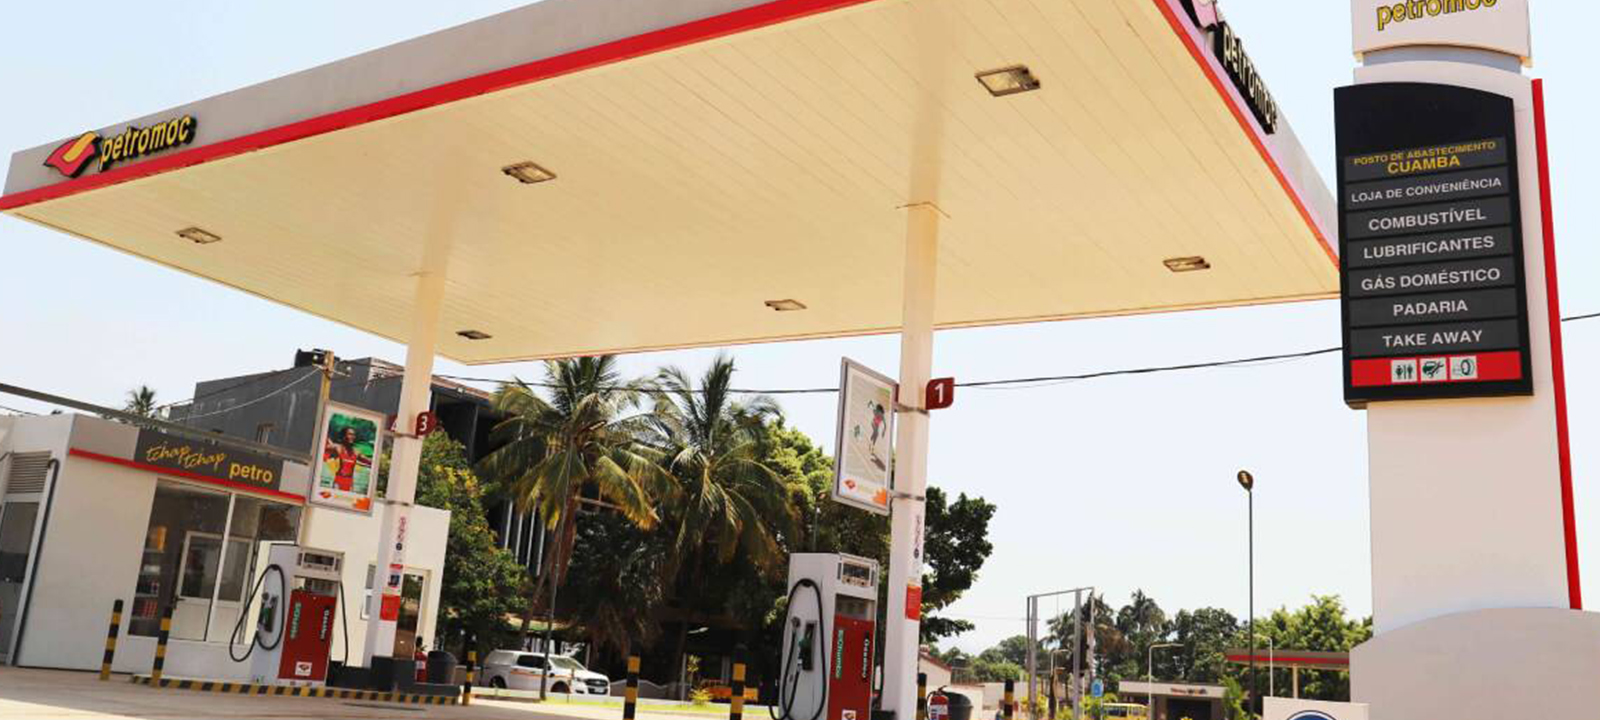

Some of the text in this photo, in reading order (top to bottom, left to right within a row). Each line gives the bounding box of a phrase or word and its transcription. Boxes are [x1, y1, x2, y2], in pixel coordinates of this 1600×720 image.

[98, 114, 195, 172] petromoc
[1353, 141, 1497, 165] POSTO DE ABASTECIMENTO
[1387, 155, 1461, 174] CUAMBA
[1351, 177, 1502, 203] LOJA DE CONVENIÊNCIA
[1368, 208, 1487, 231] COMBUSTÍVEL
[1363, 235, 1496, 259] LUBRIFICANTES
[1361, 267, 1501, 291] GÁS DOMÉSTICO
[1393, 299, 1469, 317] PADARIA
[1382, 329, 1483, 348] TAKE AWAY
[934, 382, 944, 404] 1
[419, 415, 428, 432] 3
[229, 461, 274, 483] petro
